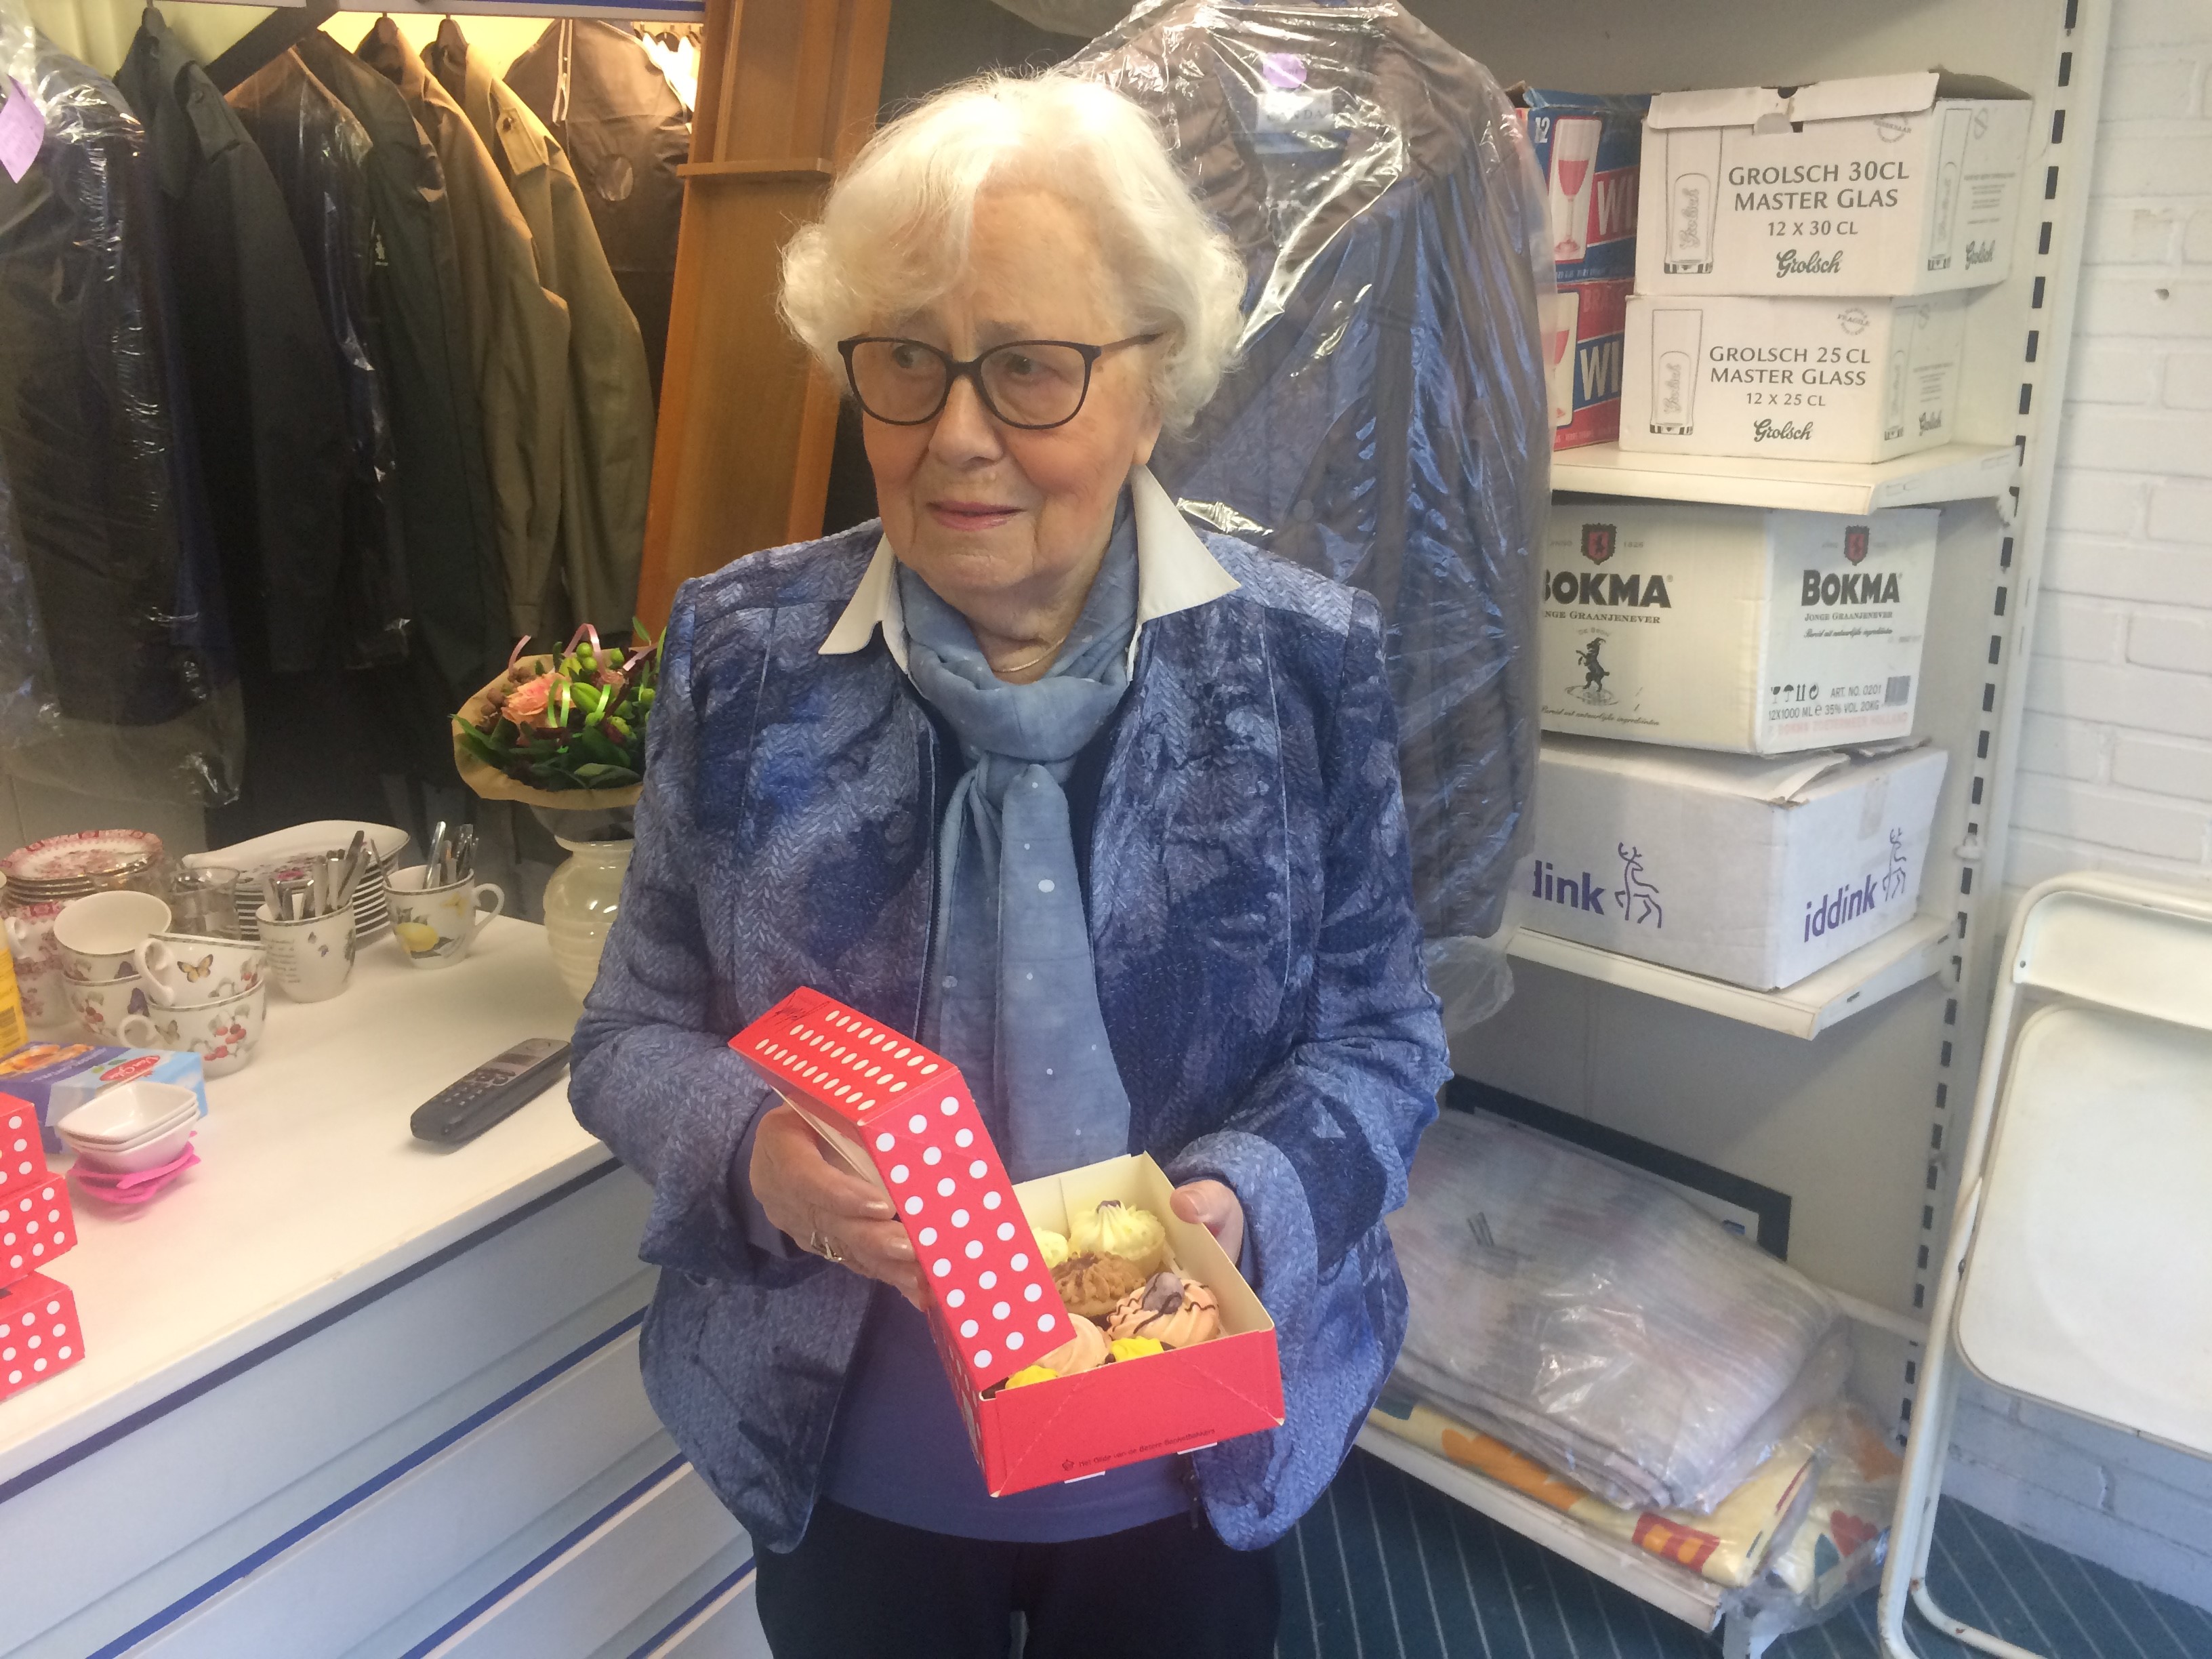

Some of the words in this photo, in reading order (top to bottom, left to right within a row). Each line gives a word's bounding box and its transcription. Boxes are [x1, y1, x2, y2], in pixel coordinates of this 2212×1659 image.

[1534, 117, 1551, 144] 12
[1728, 164, 1839, 186] GROLSCH
[1849, 161, 1910, 182] 30CL
[1597, 174, 1635, 236] WI
[1734, 190, 1828, 211] MASTER
[1837, 188, 1898, 209] GLAS
[1767, 221, 1786, 237] 12
[1792, 222, 1803, 236] X
[1809, 220, 1831, 236] 30
[1837, 221, 1858, 235] CL
[1776, 249, 1843, 279] Grolsch
[1709, 346, 1808, 363] GROLSCH
[1816, 347, 1841, 363] 25
[1845, 348, 1870, 364] CL
[1580, 340, 1620, 401] WI
[1711, 367, 1794, 384] MASTER
[1801, 368, 1866, 386] GLASS
[1746, 392, 1763, 405] 12
[1768, 394, 1778, 405] X
[1784, 393, 1802, 406] 25
[1807, 394, 1826, 407] CL
[1753, 418, 1814, 442] Grolsch
[1801, 569, 1900, 607] BOKMA
[1544, 611, 1566, 619] NGE
[1569, 611, 1660, 623] GRAANJENEVER
[1804, 613, 1830, 621] JONGE
[1832, 611, 1893, 620] GRAANJENEVER
[1830, 687, 1845, 698] ART.
[1863, 684, 1881, 695] 0201
[1768, 707, 1800, 720] 12X1000
[1801, 707, 1813, 718] ML
[1824, 703, 1842, 716] 35%
[1844, 702, 1858, 714] VOL
[1860, 699, 1880, 712] 20KG
[1804, 874, 1878, 943] iddink
